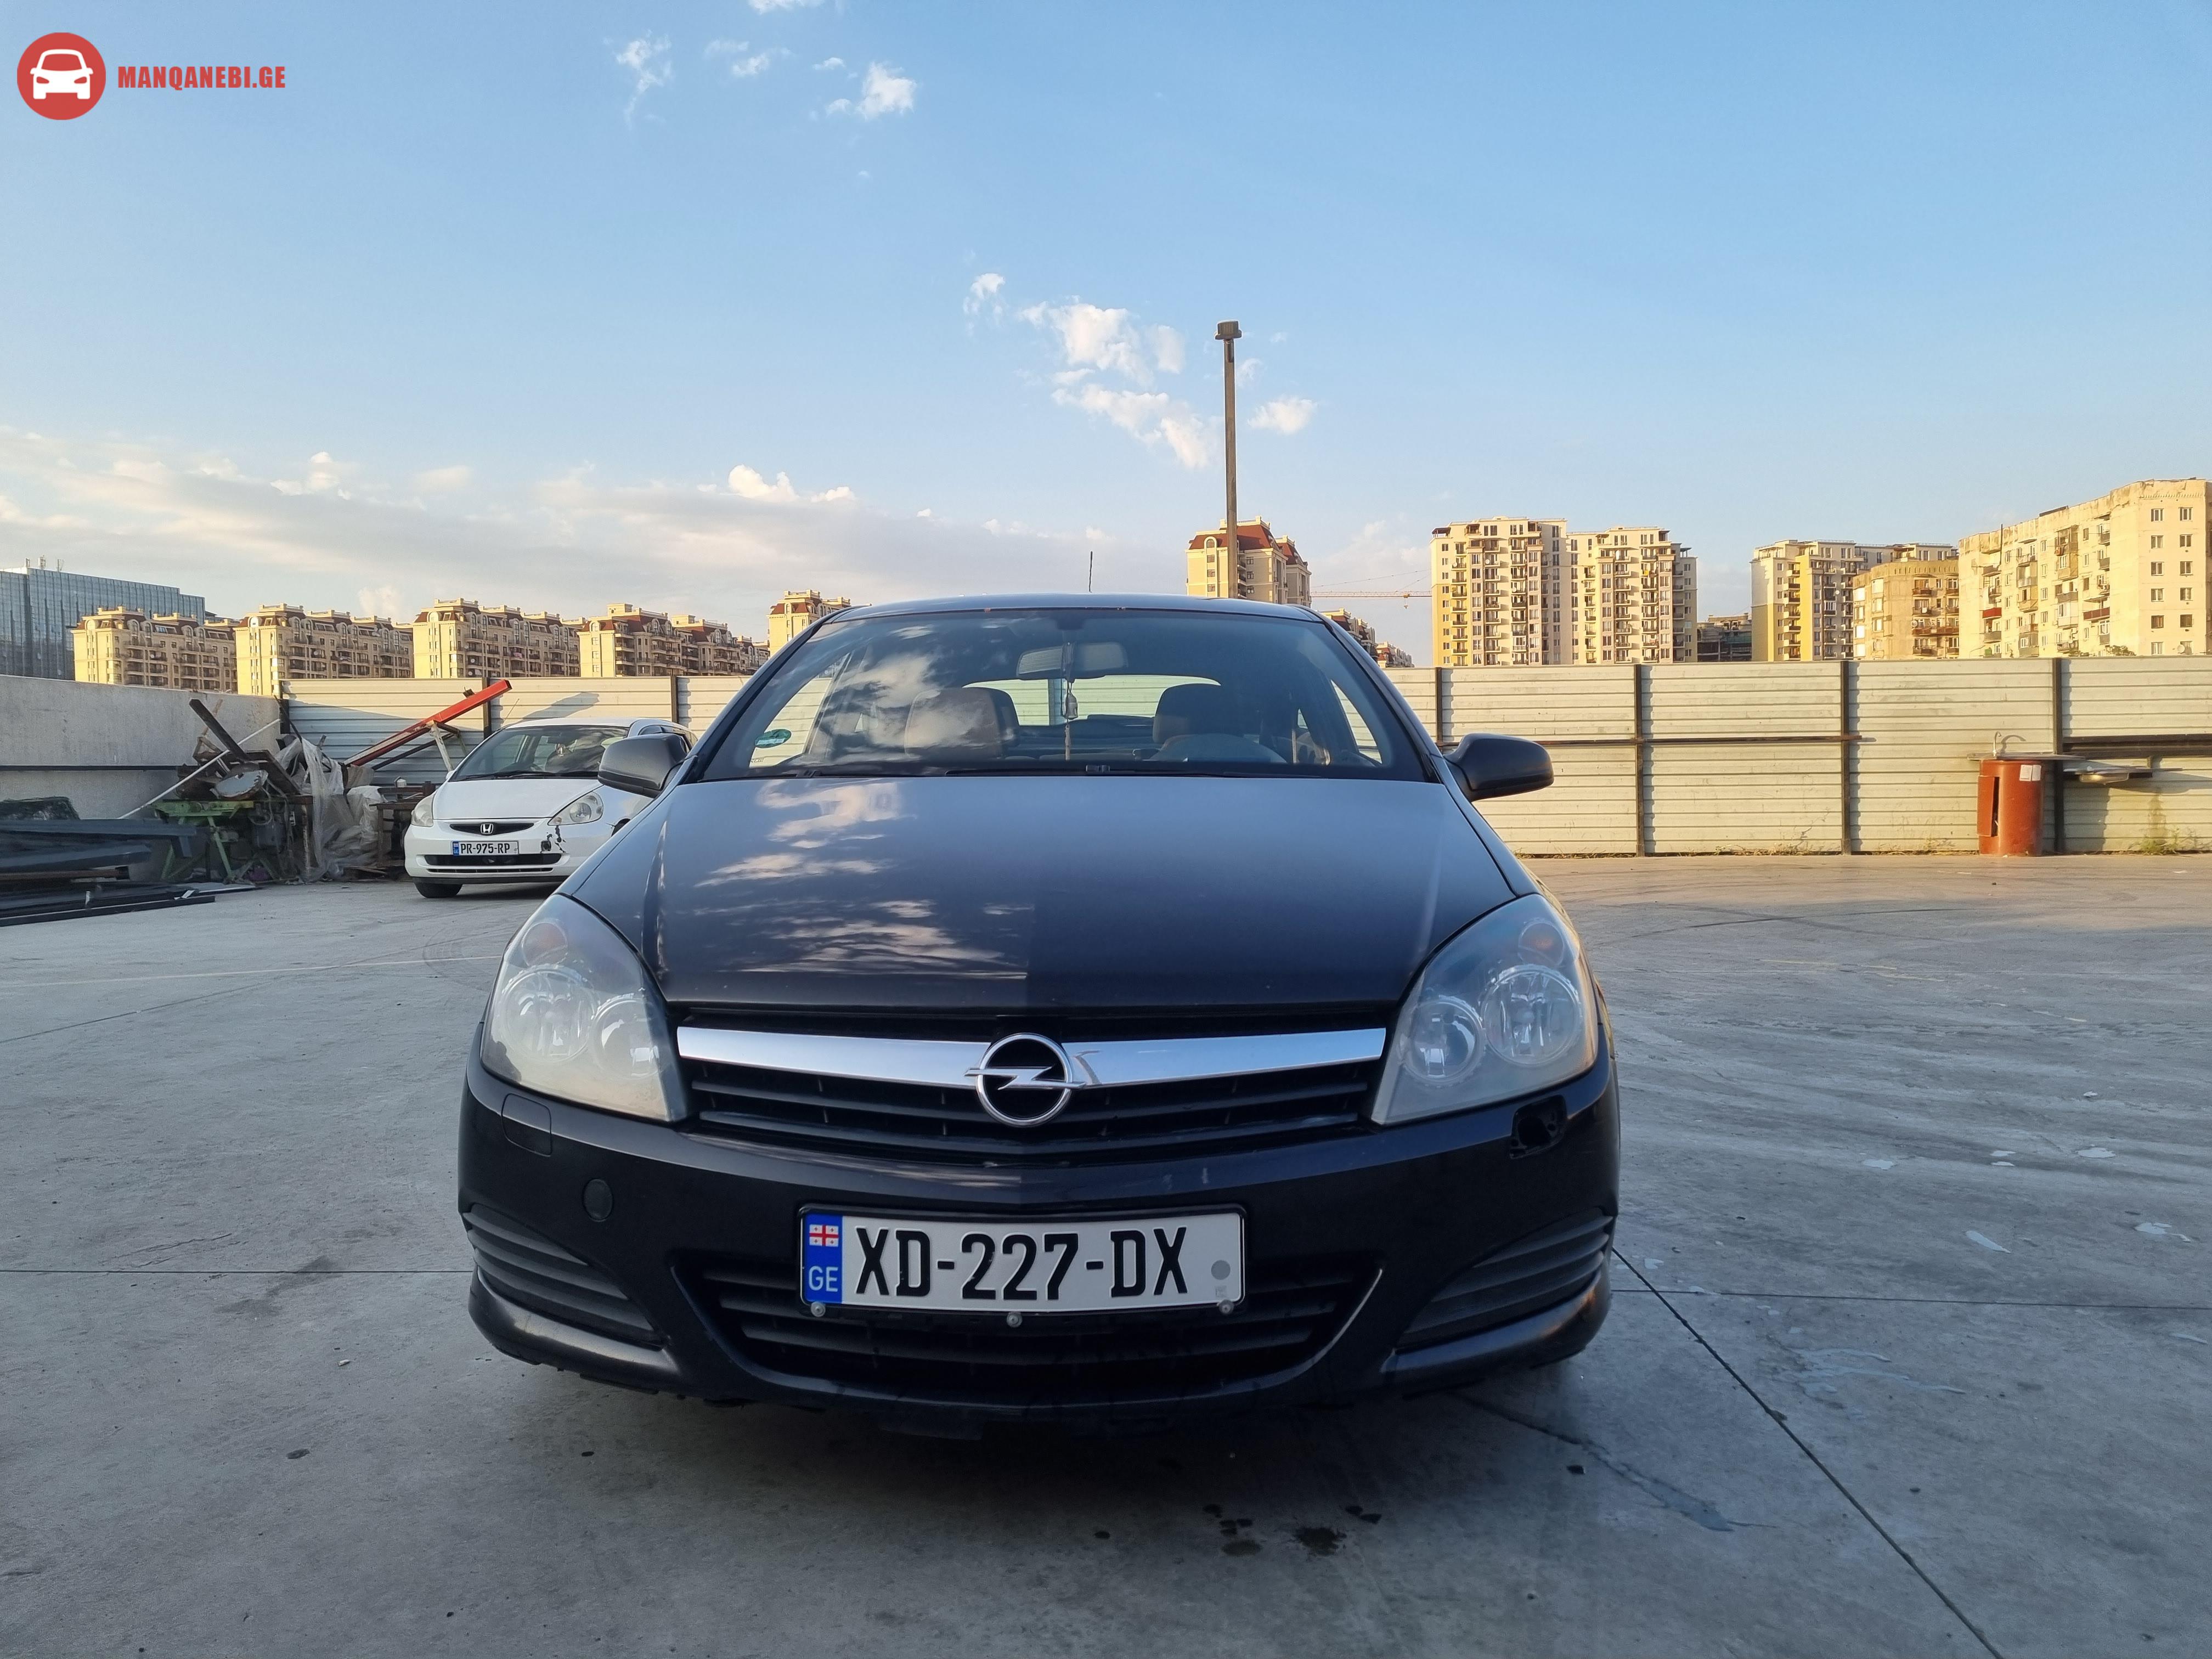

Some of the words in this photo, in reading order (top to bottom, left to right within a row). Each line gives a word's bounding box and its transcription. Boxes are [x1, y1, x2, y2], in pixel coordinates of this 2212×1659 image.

[460, 843, 510, 854] PR-975-RP
[856, 1227, 1188, 1300] XD-227-DX
[809, 1266, 838, 1292] GE
